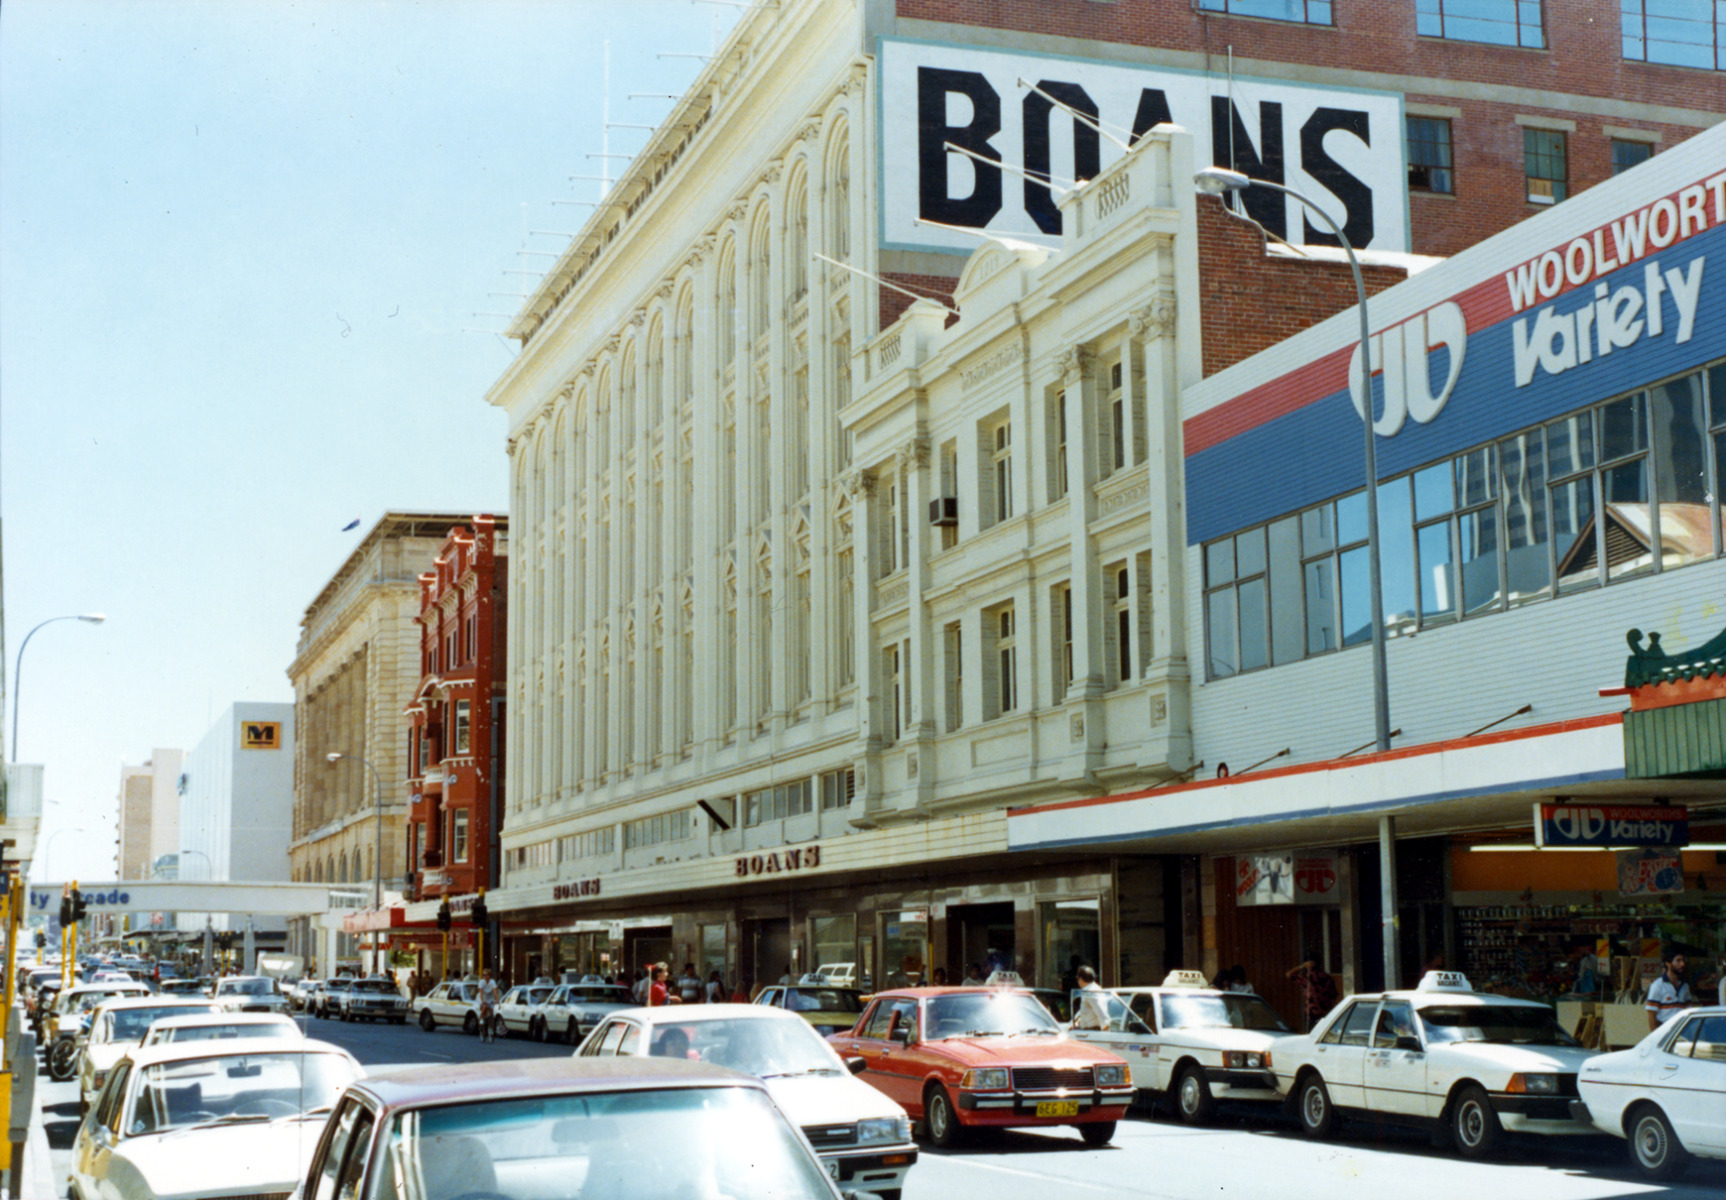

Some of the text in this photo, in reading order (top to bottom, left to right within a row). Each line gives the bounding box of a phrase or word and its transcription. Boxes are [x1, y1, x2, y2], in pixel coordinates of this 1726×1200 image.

[1512, 256, 1706, 389] Variety
[1610, 808, 1684, 820] WOOLWORTHS
[1610, 820, 1675, 843] Variety
[735, 845, 820, 877] BOANS
[81, 889, 130, 905] cade
[553, 878, 601, 900] BOANS
[1436, 972, 1462, 980] TAXI
